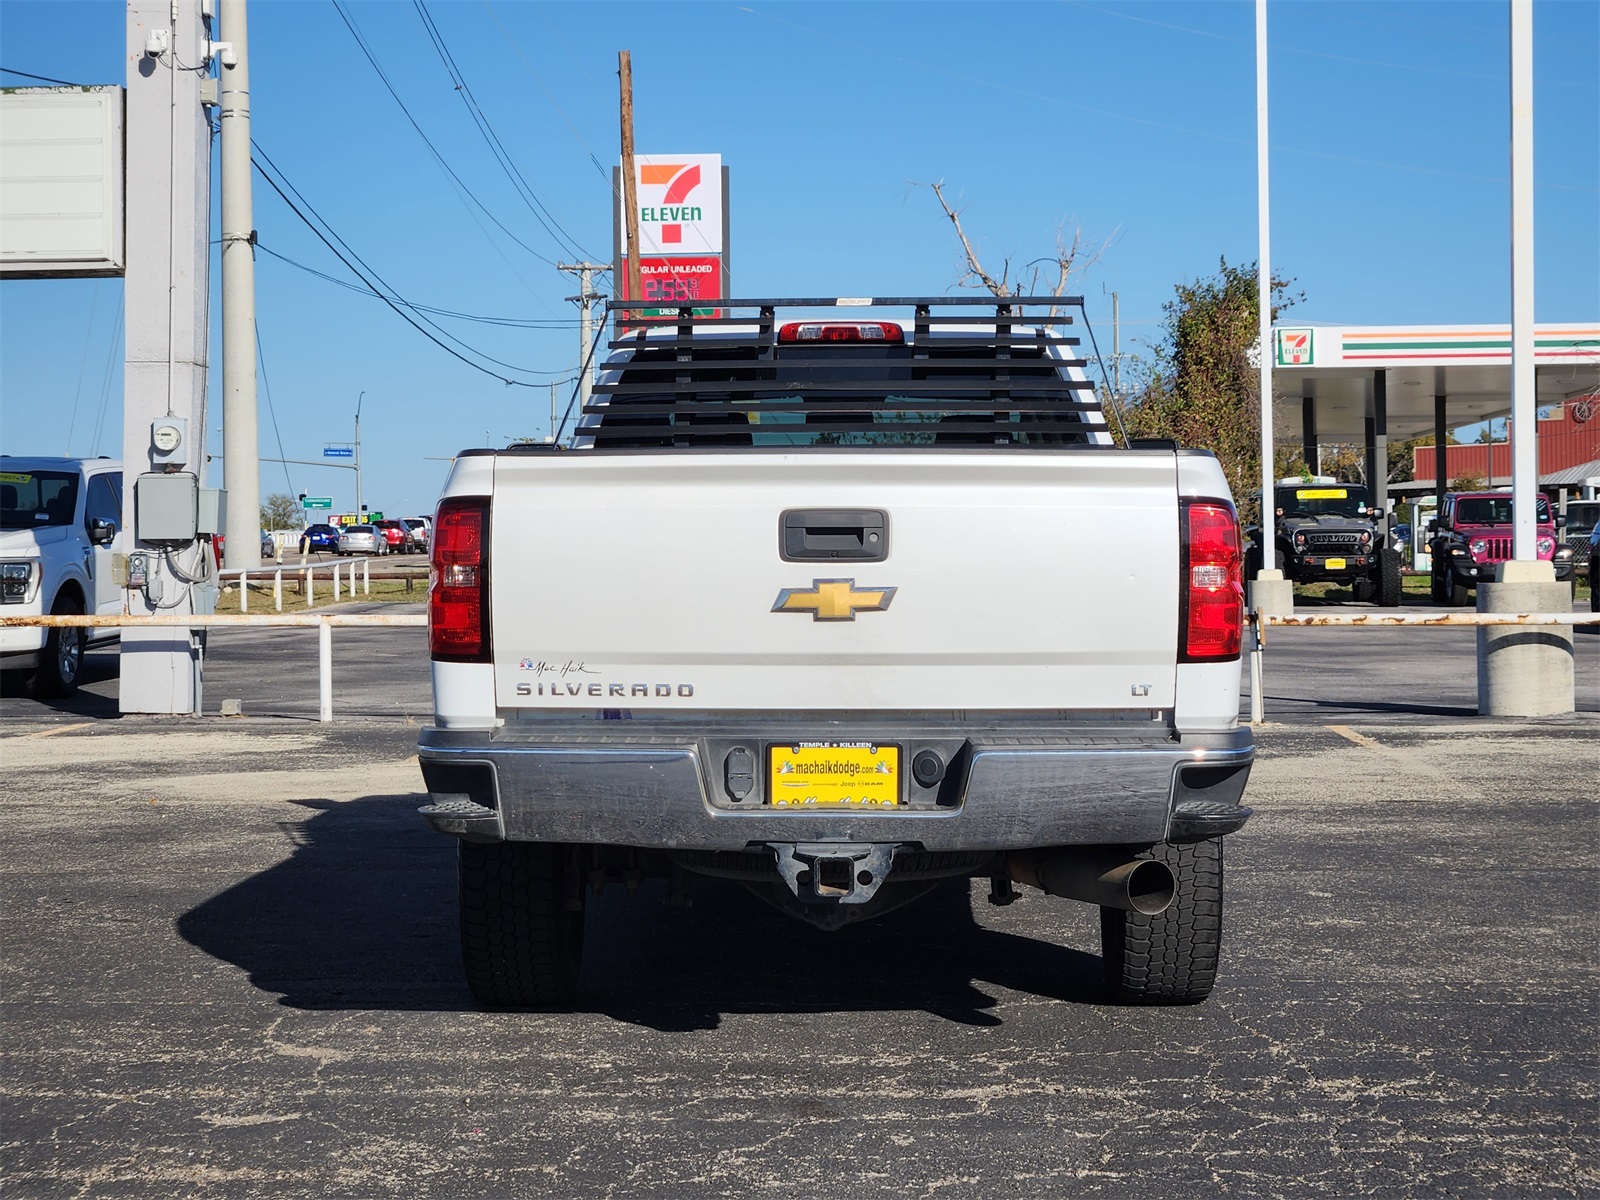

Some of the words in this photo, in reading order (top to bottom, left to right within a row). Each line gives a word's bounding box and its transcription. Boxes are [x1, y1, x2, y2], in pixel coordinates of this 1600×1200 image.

[640, 164, 701, 243] 7
[641, 265, 669, 274] GULAR
[670, 264, 713, 274] UNLEADED
[341, 515, 357, 524] EXIT
[516, 682, 695, 697] SILVERADO
[1131, 684, 1152, 696] LT
[795, 760, 874, 777] machaikdodge.com
